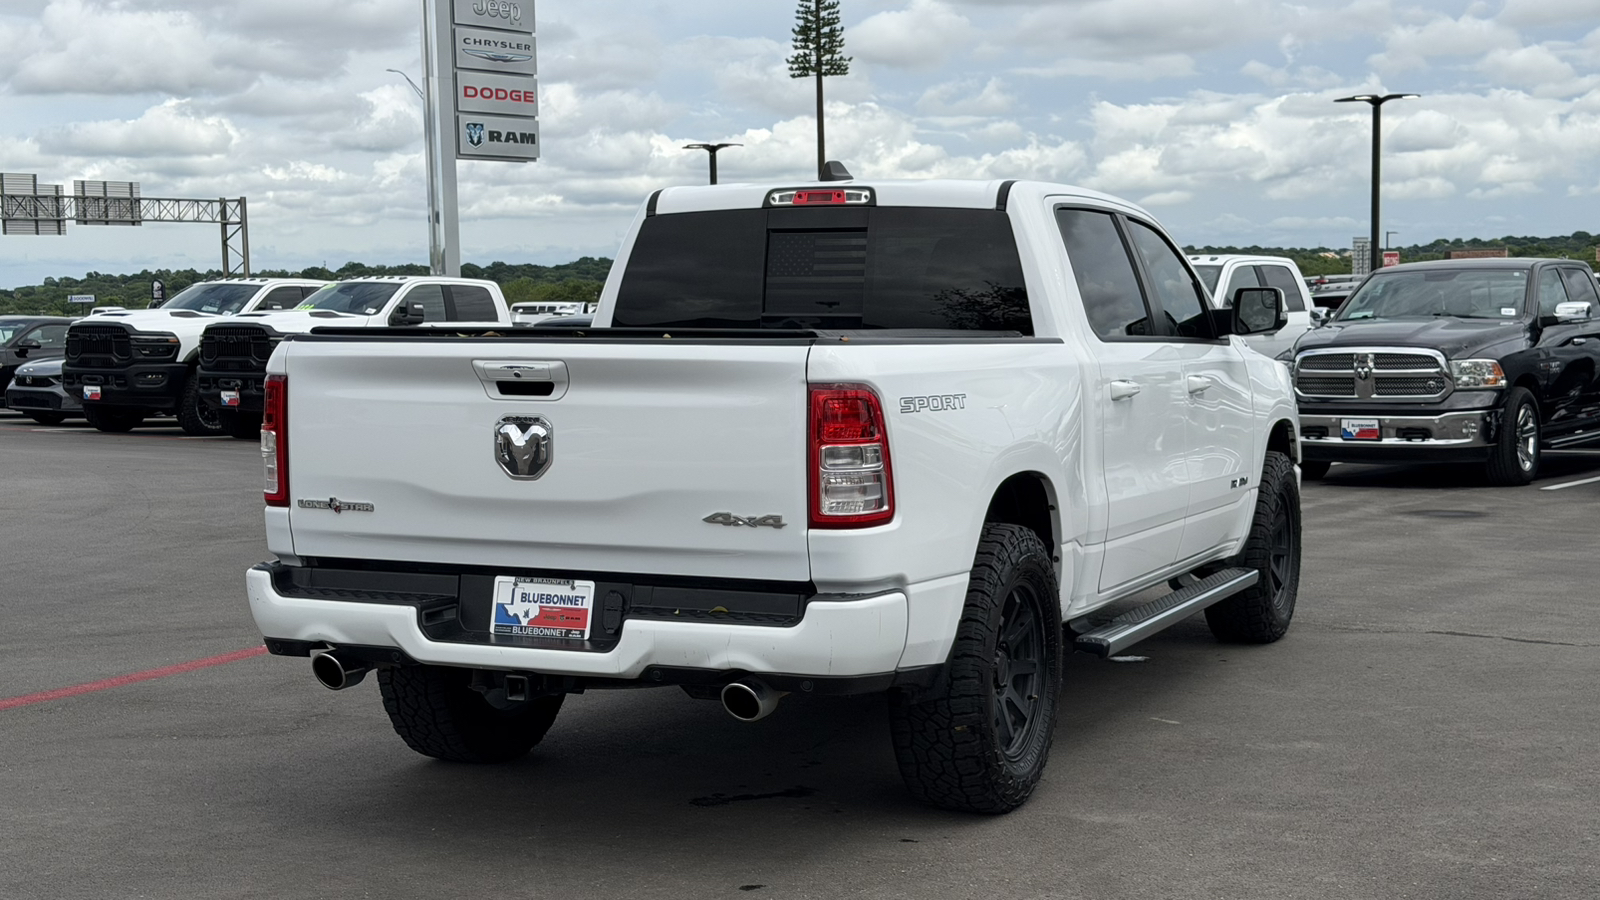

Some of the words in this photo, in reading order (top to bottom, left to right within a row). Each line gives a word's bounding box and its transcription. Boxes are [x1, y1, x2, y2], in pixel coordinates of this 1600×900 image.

[473, 0, 521, 25] Jeep
[463, 37, 531, 51] CHRYSLER
[463, 86, 535, 103] DODGE
[488, 130, 536, 145] RAM
[900, 394, 966, 413] SPORT
[298, 499, 329, 509] LONE
[340, 502, 374, 511] STAR
[533, 577, 574, 585] BRAUNFELS
[520, 592, 586, 606] BLUEBONNET
[512, 626, 567, 637] BLUEBONNET
